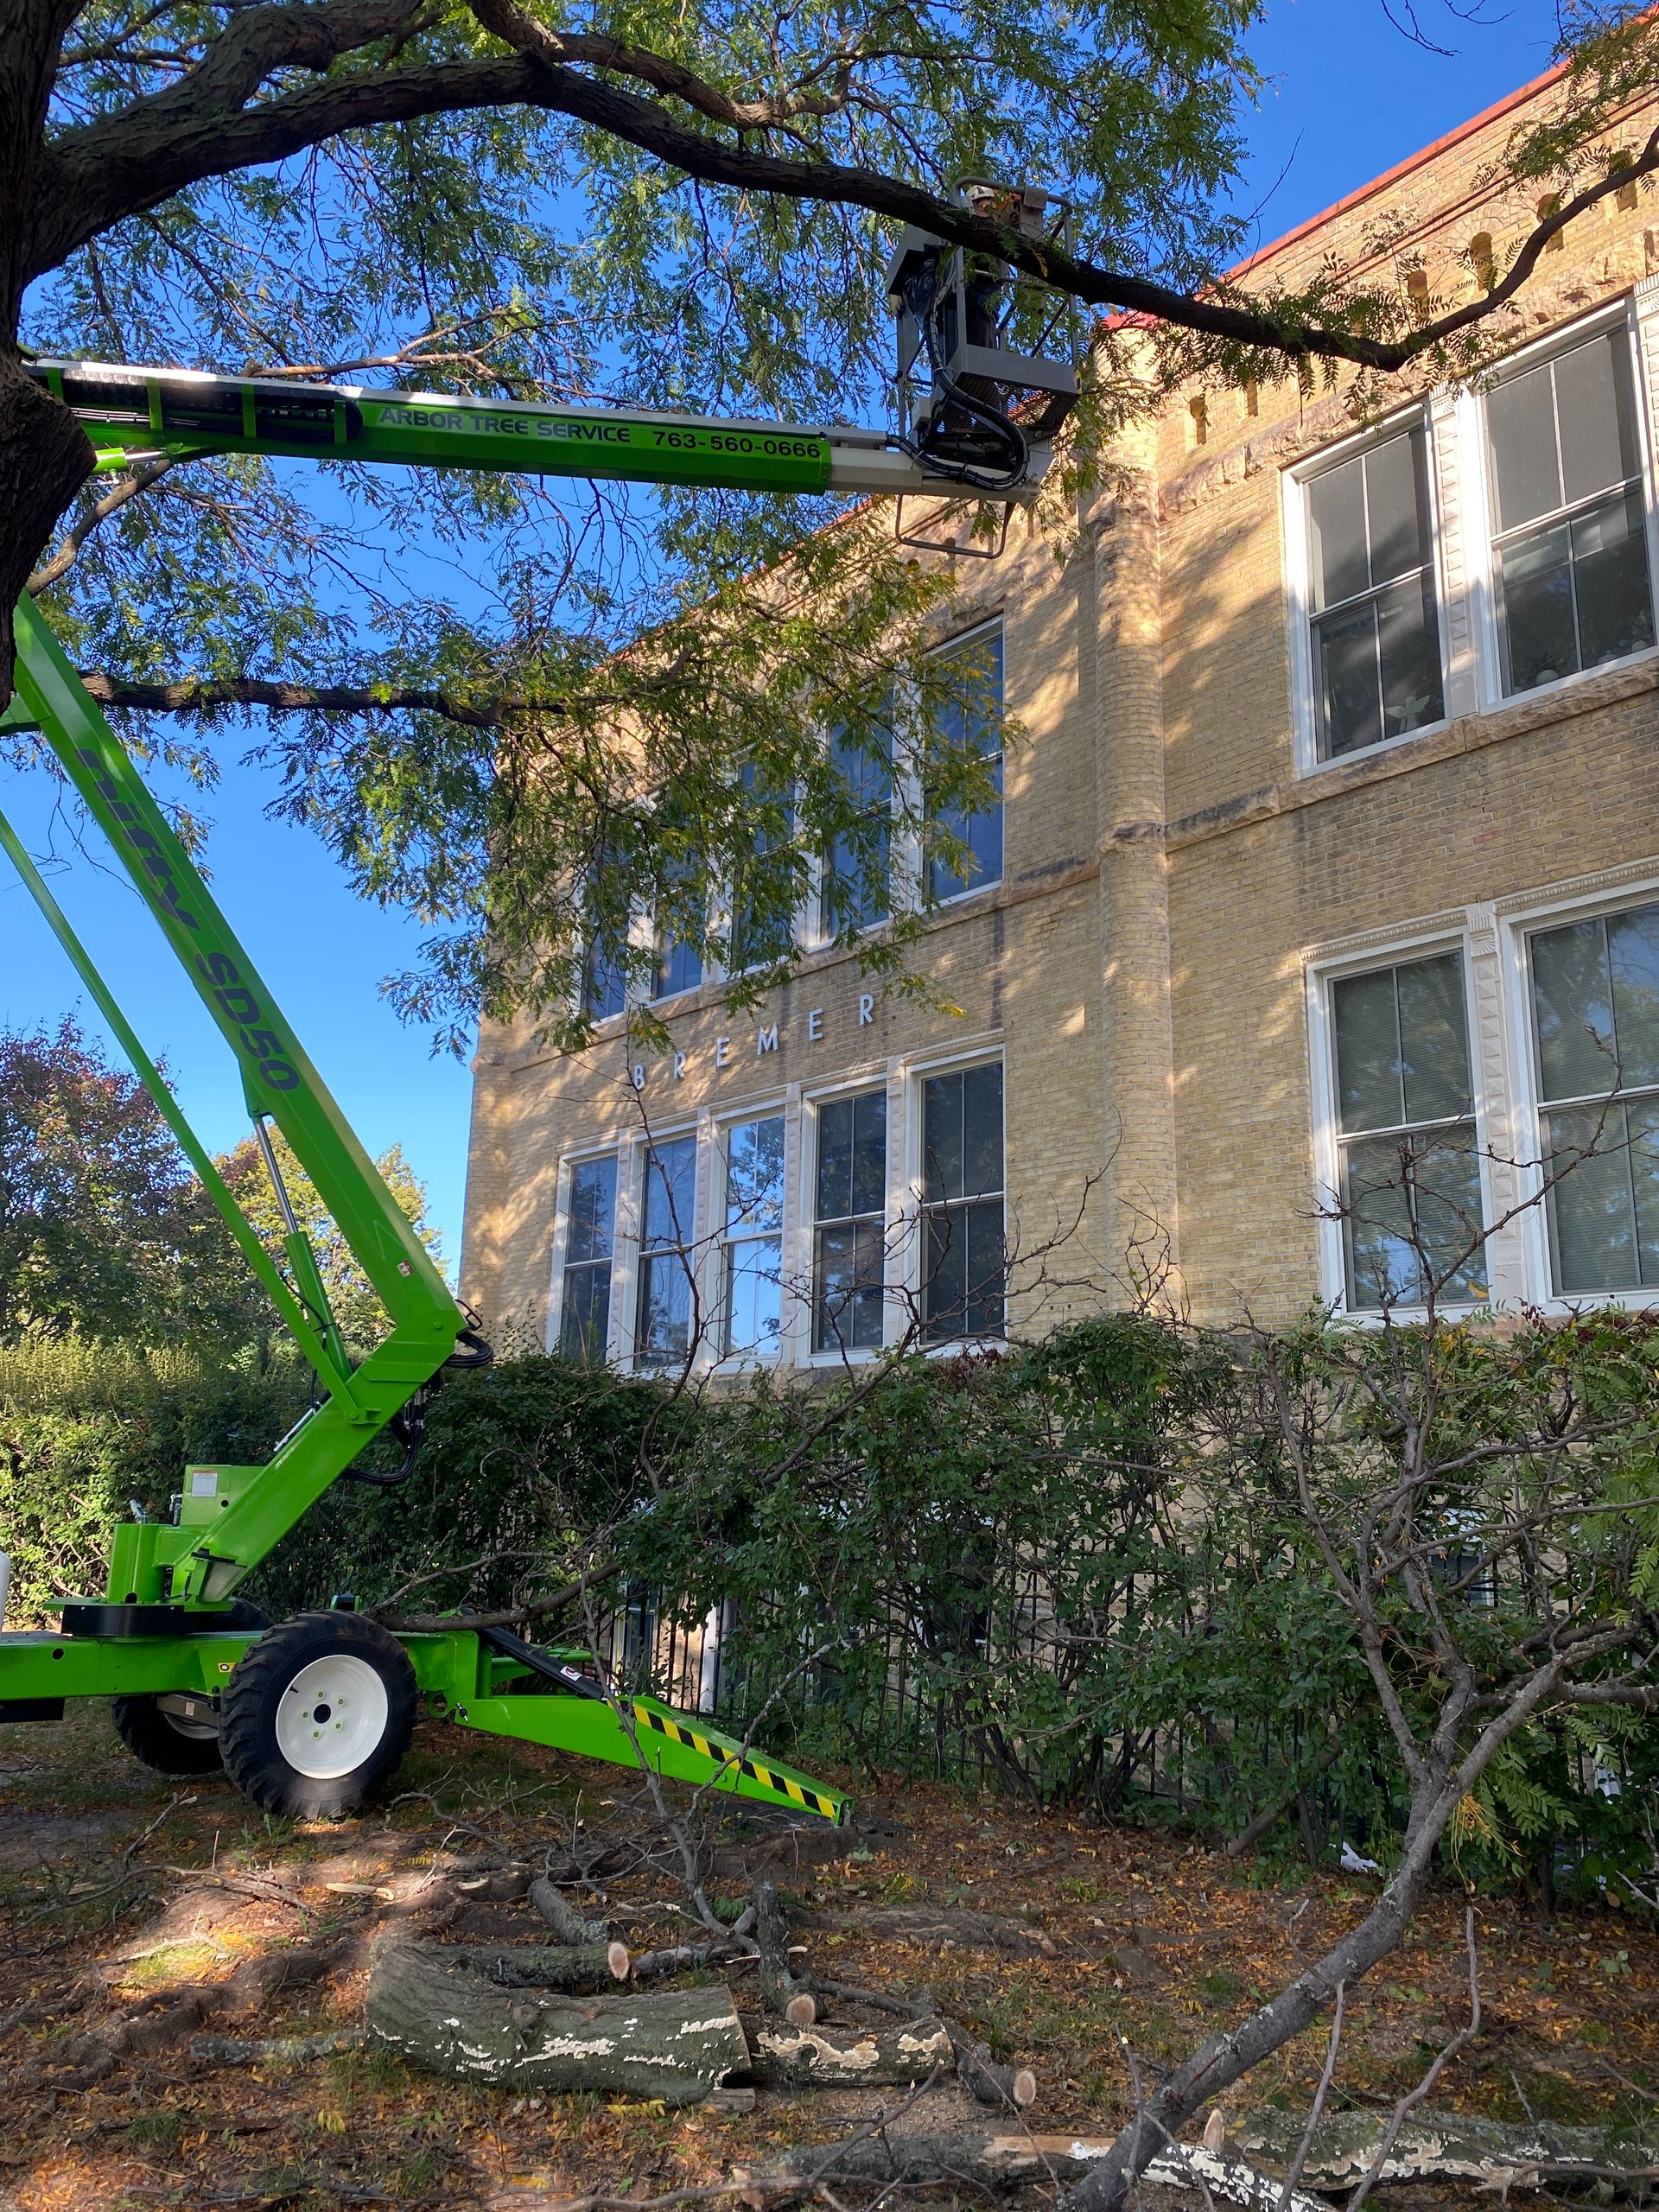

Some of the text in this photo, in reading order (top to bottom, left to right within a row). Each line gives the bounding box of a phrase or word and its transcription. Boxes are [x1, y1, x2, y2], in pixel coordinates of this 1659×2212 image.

[378, 407, 821, 459] ARBOR TREE SERVICE 763-560-0666
[74, 747, 300, 1091] nifty SD50
[633, 994, 874, 1091] BREMER
